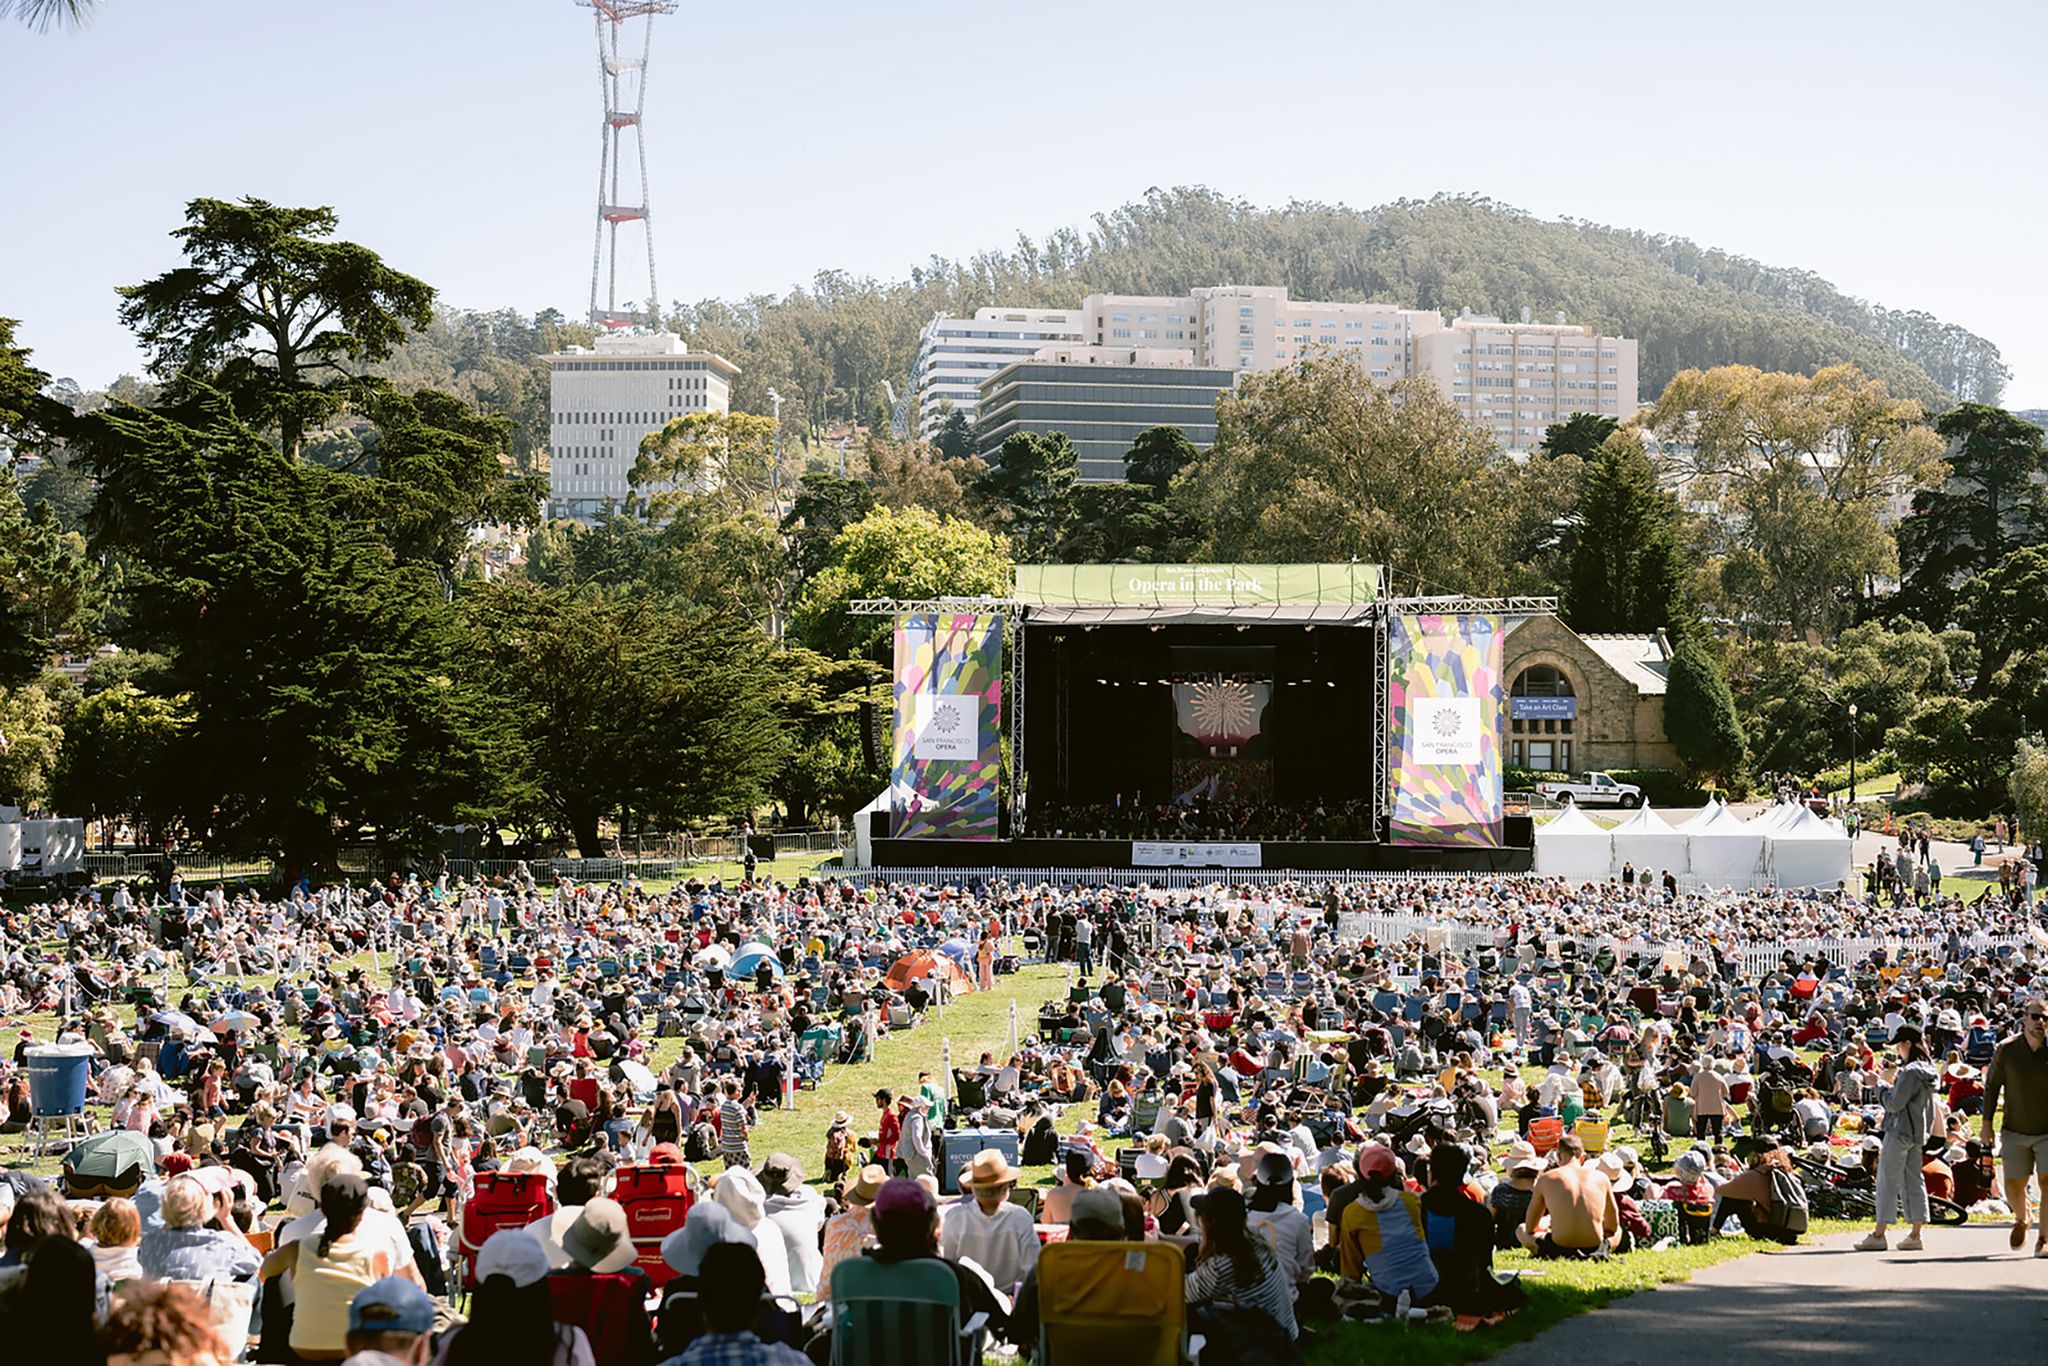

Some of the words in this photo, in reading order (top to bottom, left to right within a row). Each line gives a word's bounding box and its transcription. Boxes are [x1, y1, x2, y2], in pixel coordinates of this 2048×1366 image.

[1128, 577, 1176, 594] Opera
[1180, 576, 1194, 592] in
[1199, 576, 1222, 592] the
[1226, 576, 1263, 592] Park
[936, 737, 971, 745] FRANCISCO
